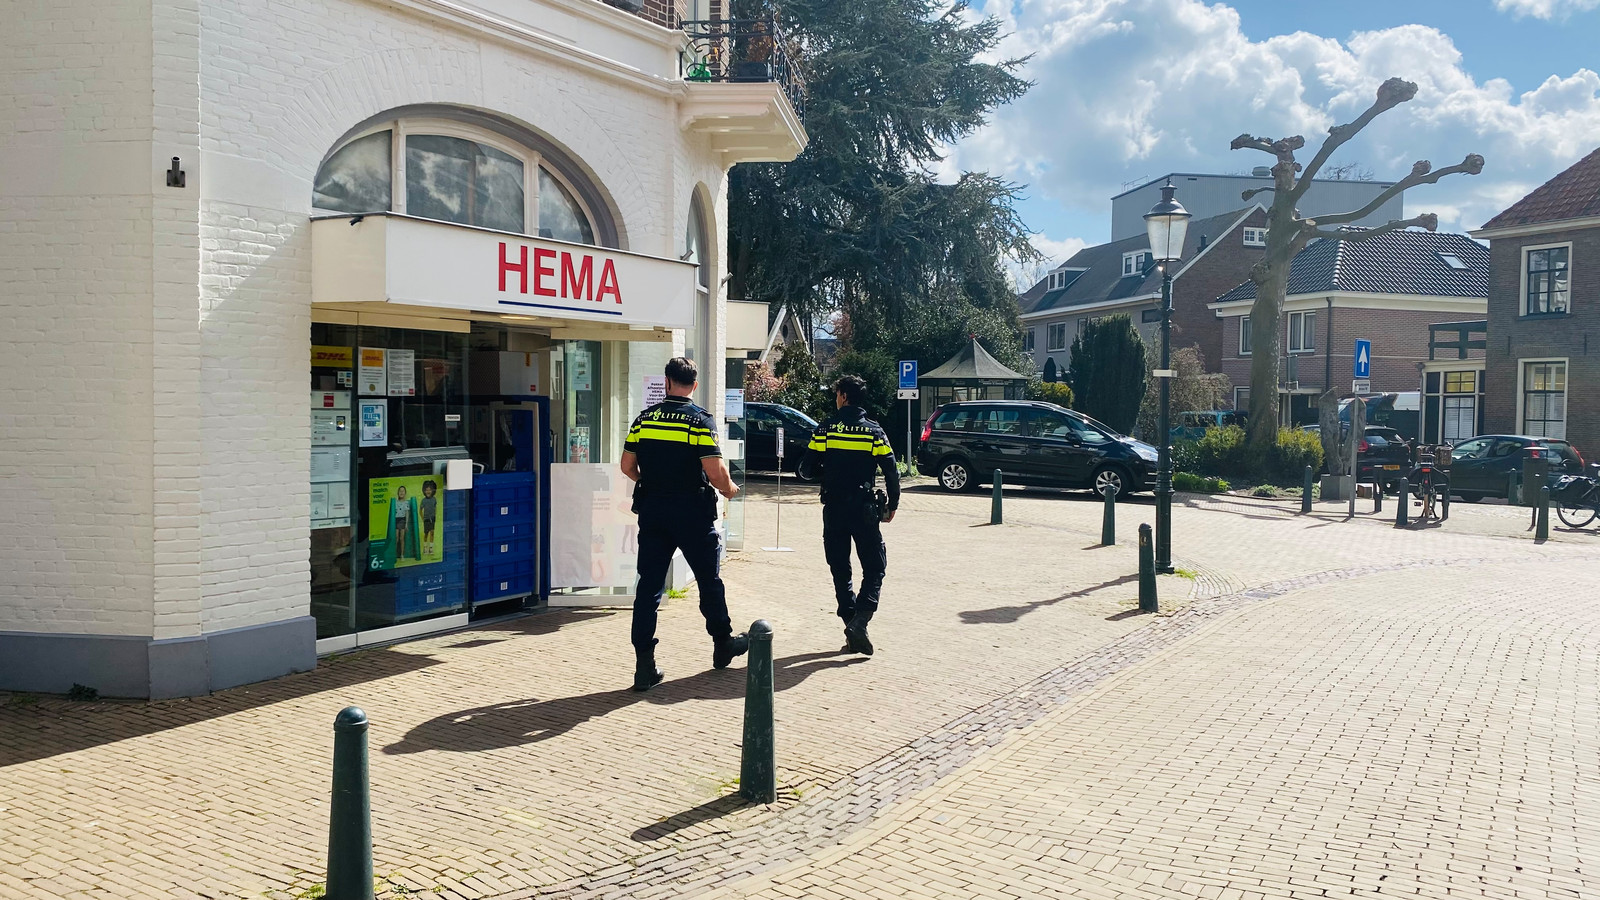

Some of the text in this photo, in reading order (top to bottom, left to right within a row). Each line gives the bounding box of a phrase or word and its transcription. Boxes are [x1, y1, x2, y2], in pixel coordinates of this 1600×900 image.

[498, 242, 622, 304] HEMA
[903, 363, 913, 377] P
[649, 408, 686, 421] POLITIE
[832, 421, 870, 433] POLITIE
